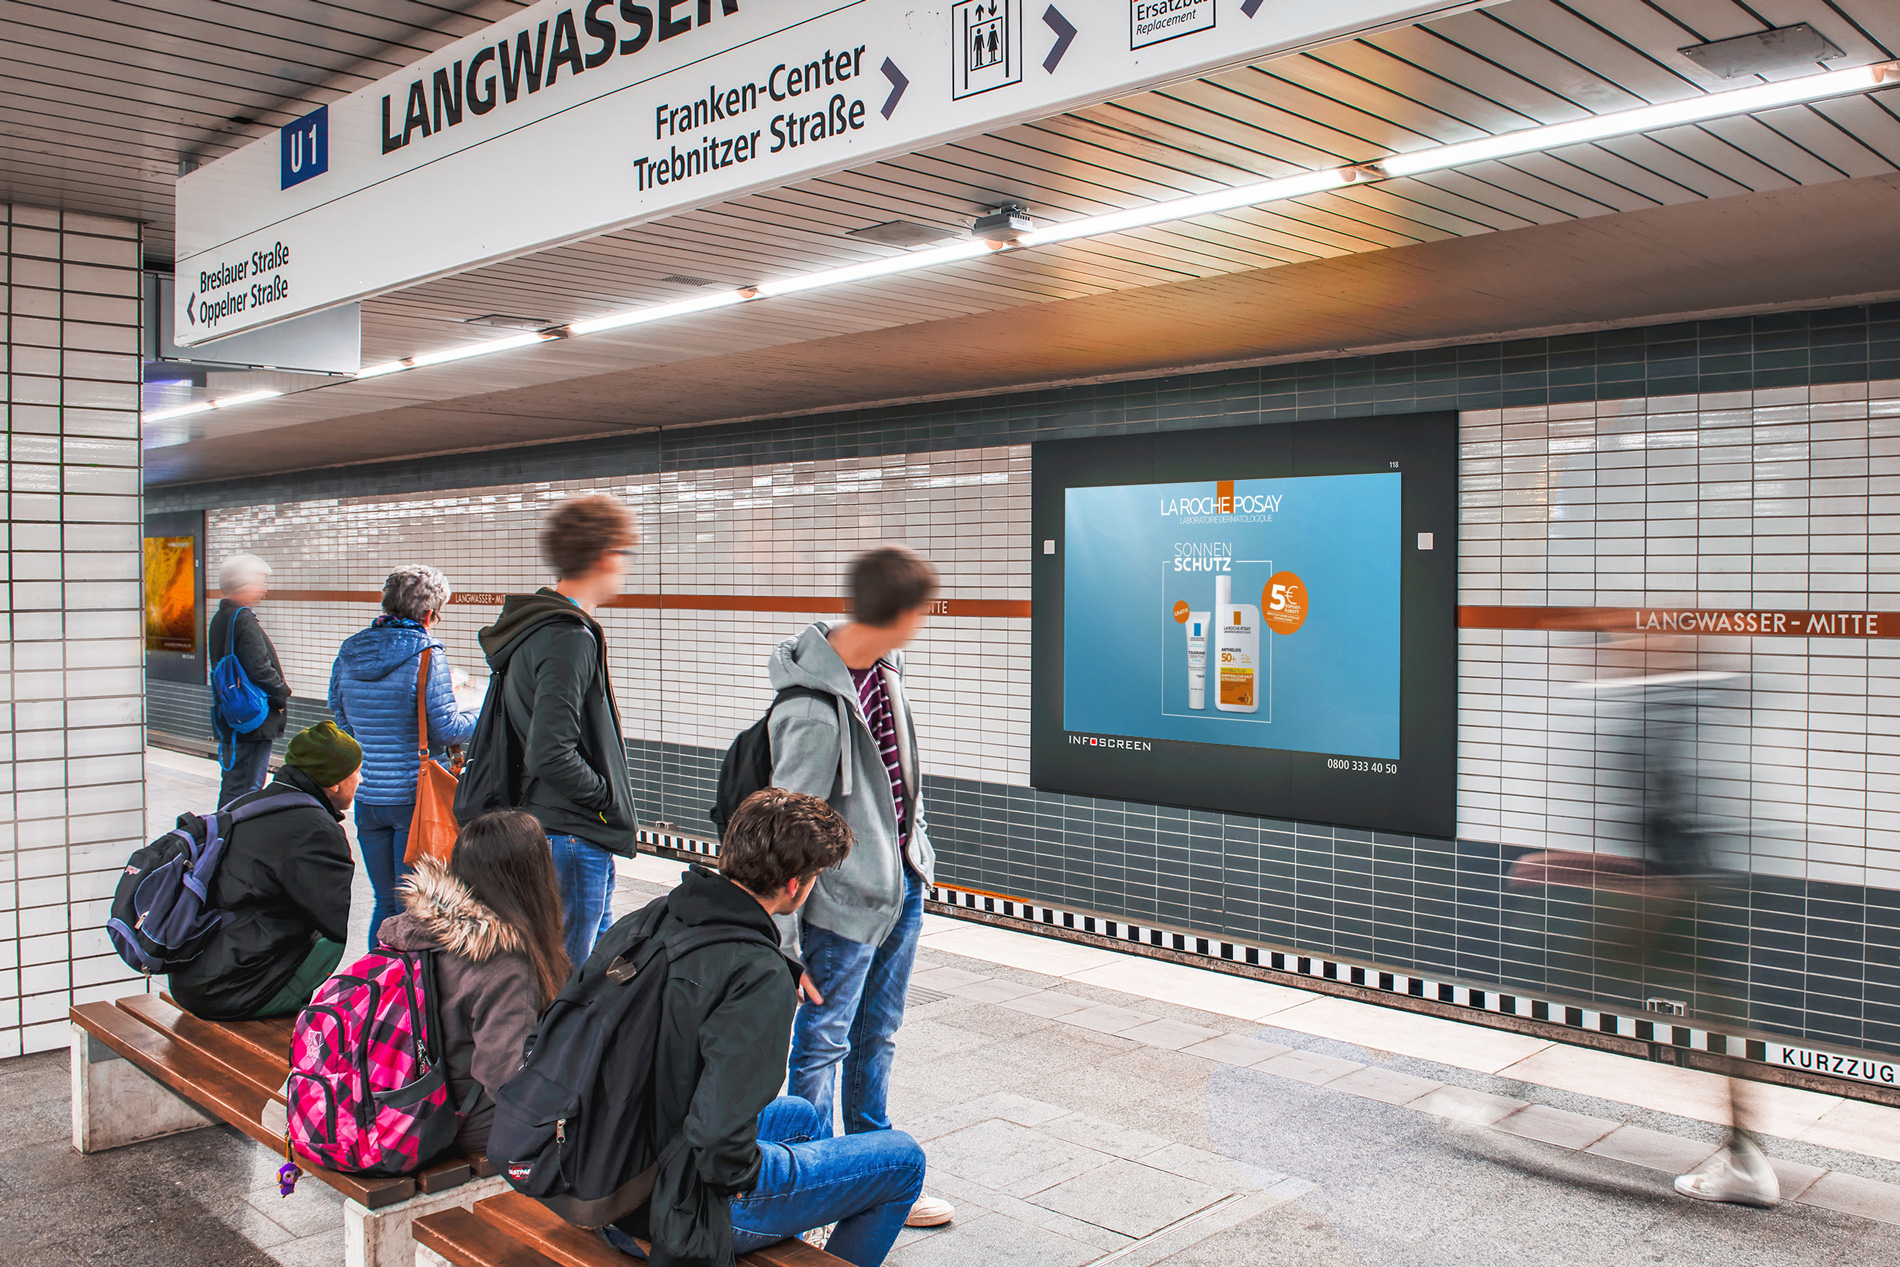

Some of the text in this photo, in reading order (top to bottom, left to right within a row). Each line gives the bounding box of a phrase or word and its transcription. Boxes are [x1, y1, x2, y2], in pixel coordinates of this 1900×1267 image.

[1137, 0, 1209, 21] Ersatz
[1136, 9, 1196, 35] Replacement
[656, 44, 866, 140] Franken-Center
[633, 93, 866, 191] Trebnitzer Straße
[200, 240, 289, 294] Breslauer Straße
[199, 274, 288, 328] Oppelner Straße
[1160, 498, 1179, 516] LA
[1179, 514, 1273, 525] LABORATOIRE DERMATOLOGIQUE
[1174, 542, 1232, 557] SONNEN
[1174, 557, 1232, 572] SCHUTZ
[1068, 735, 1151, 751] INFOSCREEN
[1327, 758, 1398, 775] 0800 333 40 50
[1782, 1047, 1895, 1083] KURZZUG
